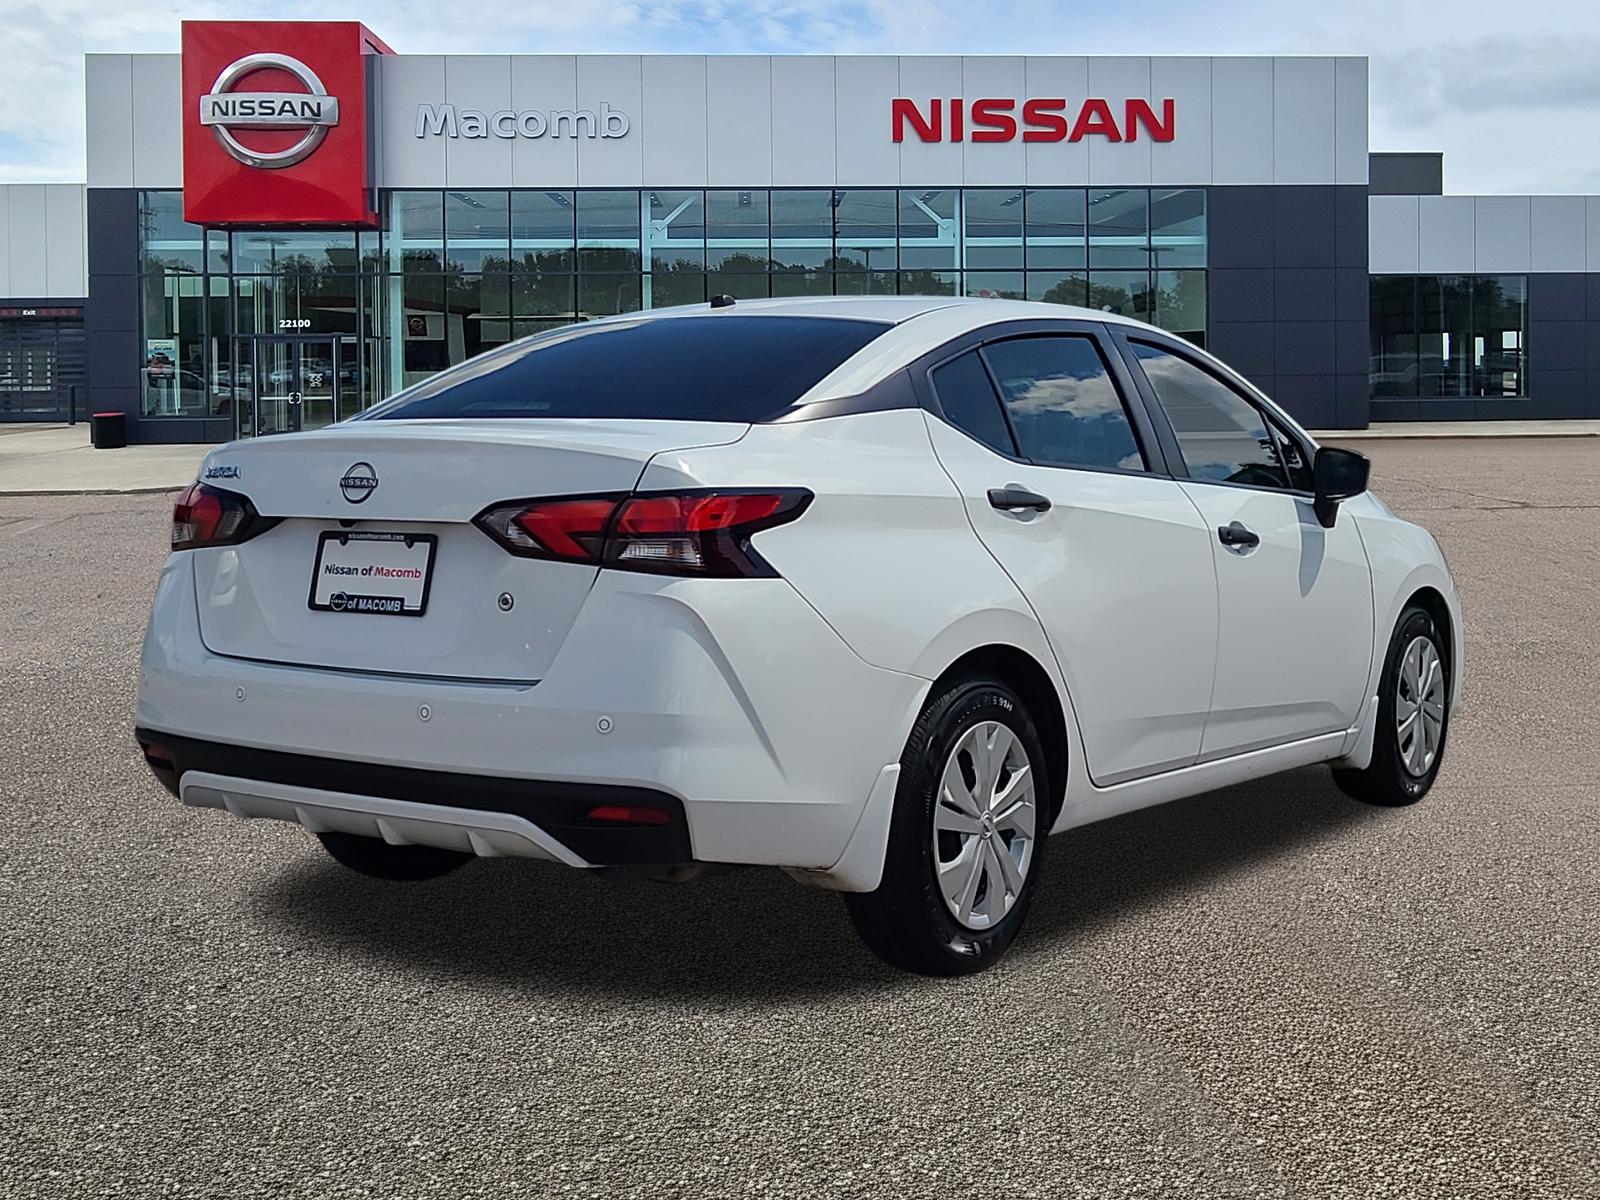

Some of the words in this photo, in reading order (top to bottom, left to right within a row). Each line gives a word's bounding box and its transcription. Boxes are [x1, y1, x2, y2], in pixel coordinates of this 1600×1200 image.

[211, 99, 323, 118] NISSAN
[414, 102, 631, 139] Macomb
[892, 98, 1175, 142] NISSAN
[279, 319, 311, 328] 22100
[340, 478, 377, 487] NISSAN
[324, 563, 359, 576] Nissan
[361, 565, 373, 577] of
[374, 566, 422, 579] Macomb
[347, 597, 358, 609] of
[358, 598, 402, 612] MACOMB
